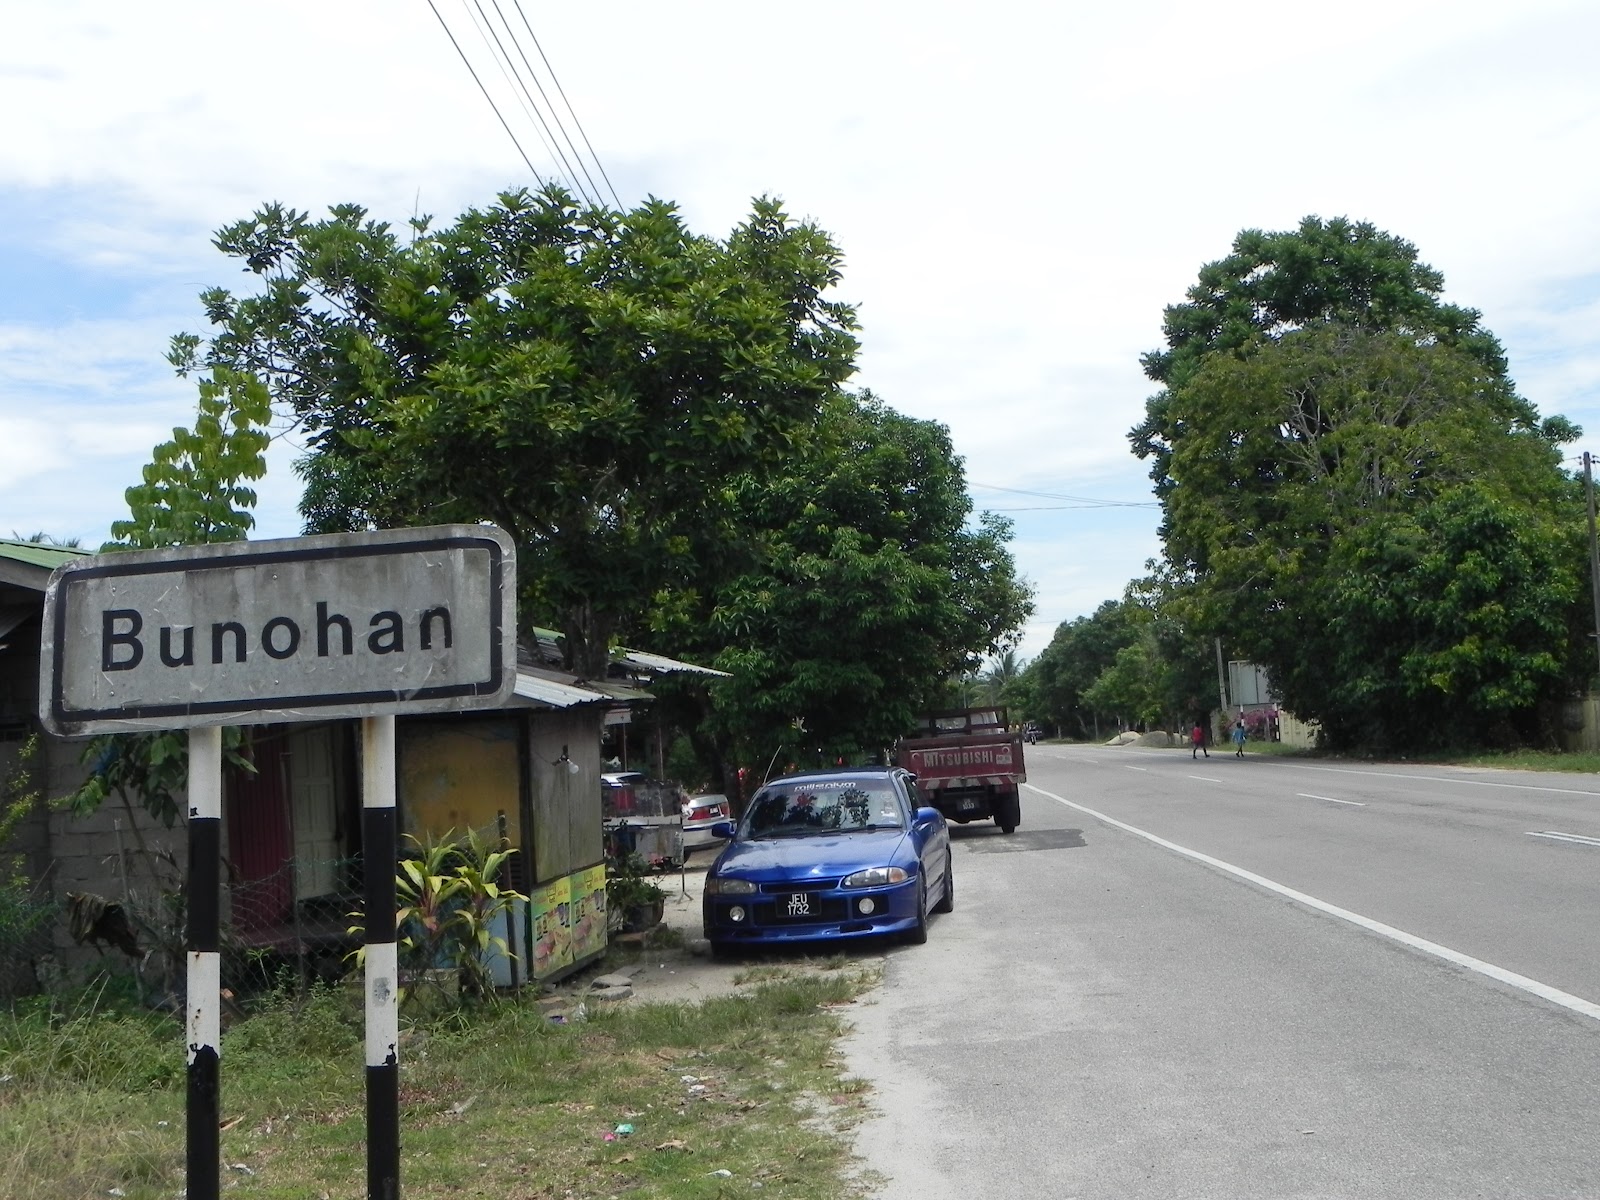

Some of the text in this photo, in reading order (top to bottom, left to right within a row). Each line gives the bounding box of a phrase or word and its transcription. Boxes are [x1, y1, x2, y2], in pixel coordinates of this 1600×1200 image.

[101, 601, 454, 672] Bunohan
[923, 750, 993, 767] MITSUBISHI
[788, 893, 808, 905] JEU
[787, 903, 810, 916] 1732
